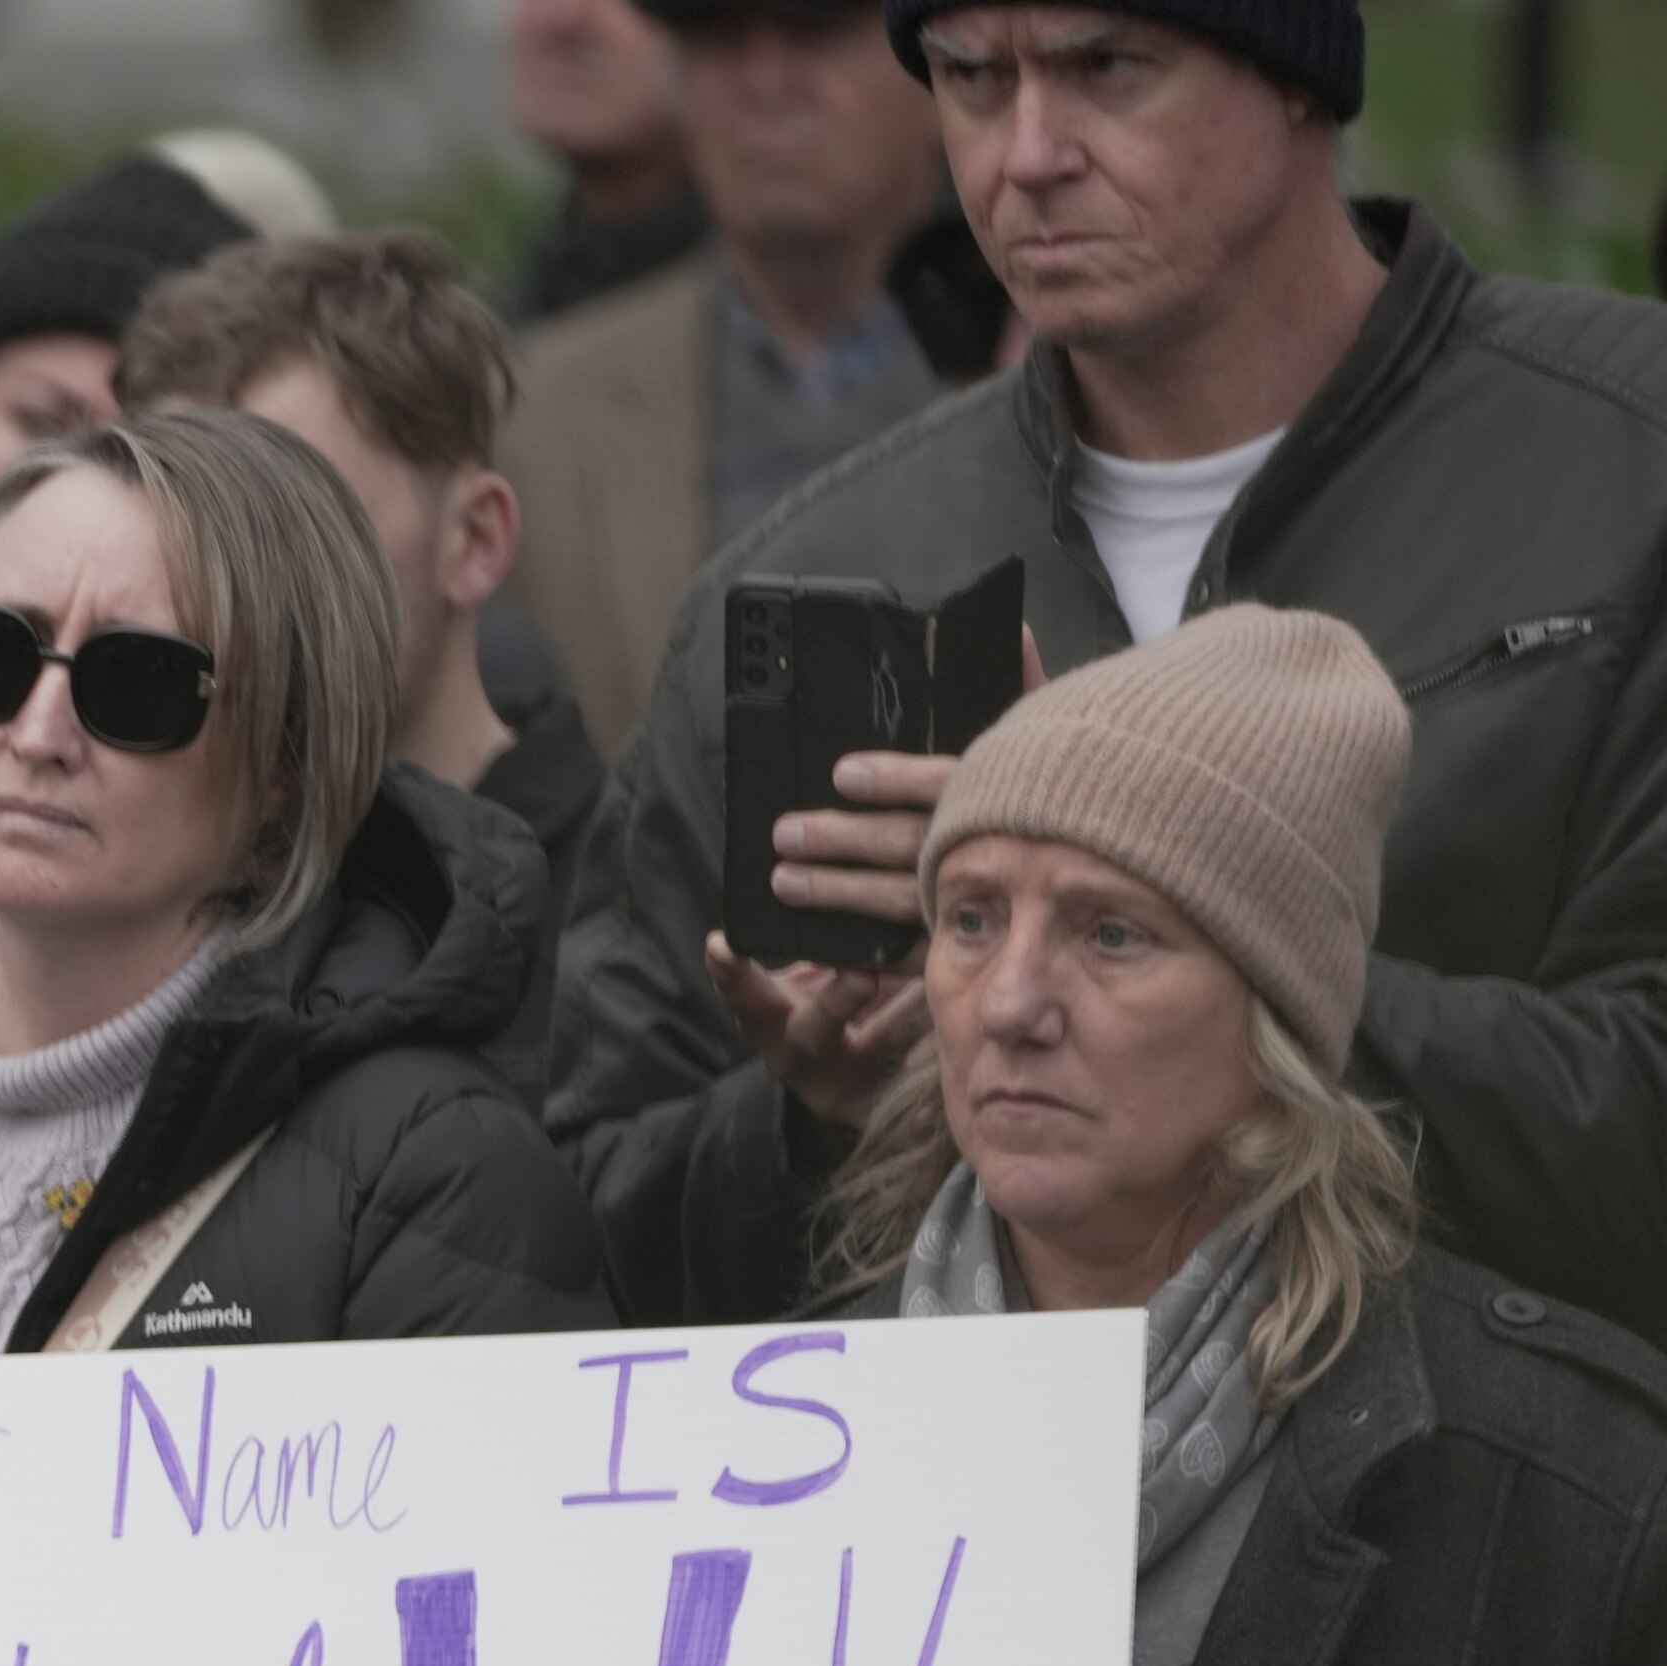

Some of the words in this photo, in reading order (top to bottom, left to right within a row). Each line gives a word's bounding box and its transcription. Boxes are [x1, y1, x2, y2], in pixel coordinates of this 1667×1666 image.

[144, 1301, 253, 1338] Kathmandu
[112, 1366, 407, 1538] Name
[561, 1331, 853, 1508] IS
